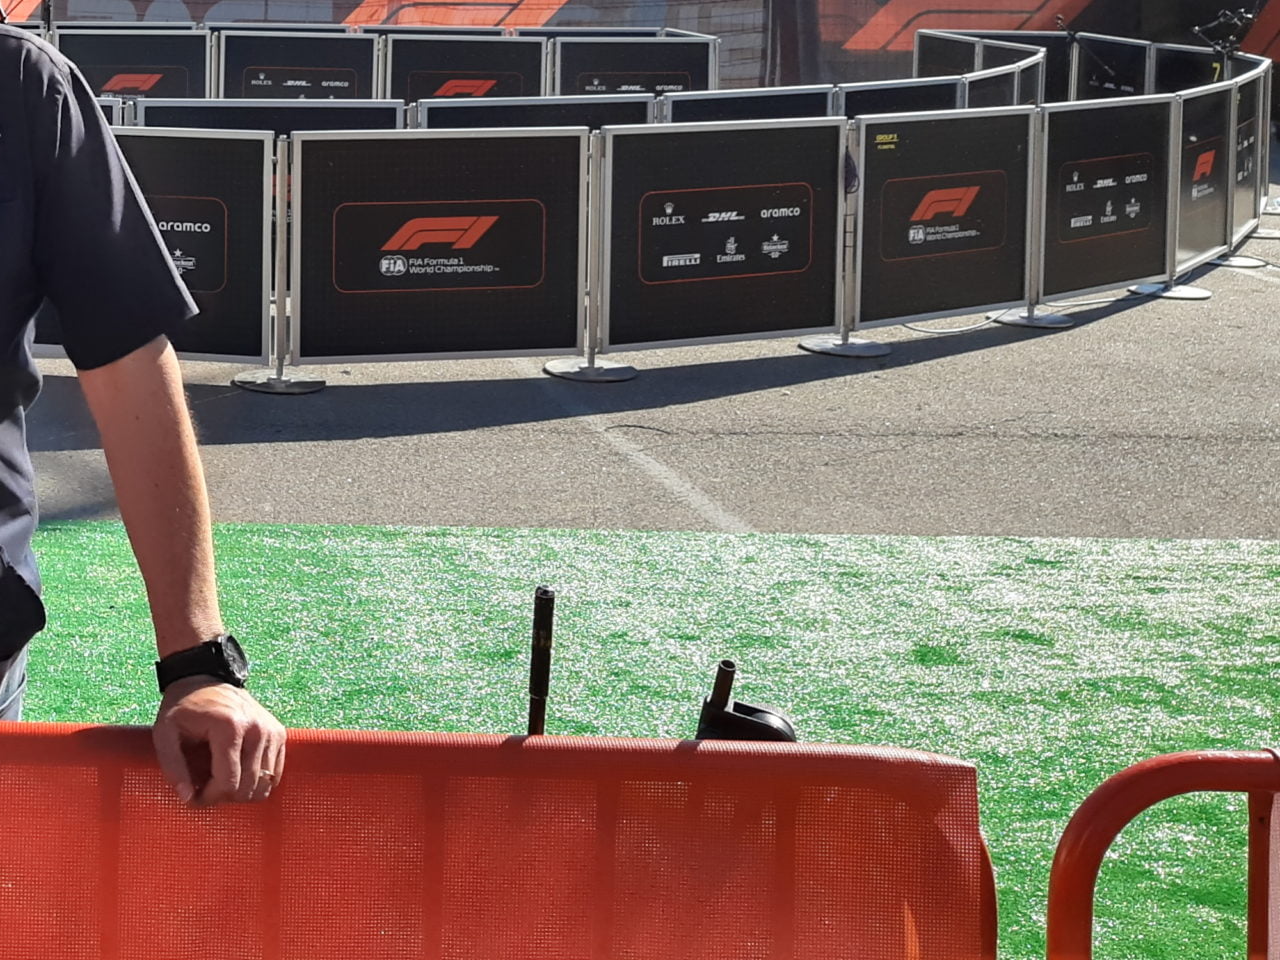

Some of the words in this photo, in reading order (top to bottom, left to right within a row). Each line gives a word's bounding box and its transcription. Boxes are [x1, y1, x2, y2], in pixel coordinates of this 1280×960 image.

[101, 74, 163, 91] F1
[433, 80, 497, 96] F1
[910, 186, 980, 221] F1
[652, 215, 685, 226] ROLEX
[701, 211, 745, 223] DHL
[760, 207, 801, 218] aramco
[158, 221, 211, 233] aramco
[380, 215, 500, 251] F1
[424, 257, 458, 266] Formula
[662, 253, 701, 267] PIRELLI
[716, 254, 746, 263] Emirates
[409, 265, 434, 274] World
[435, 263, 494, 274] Championship
